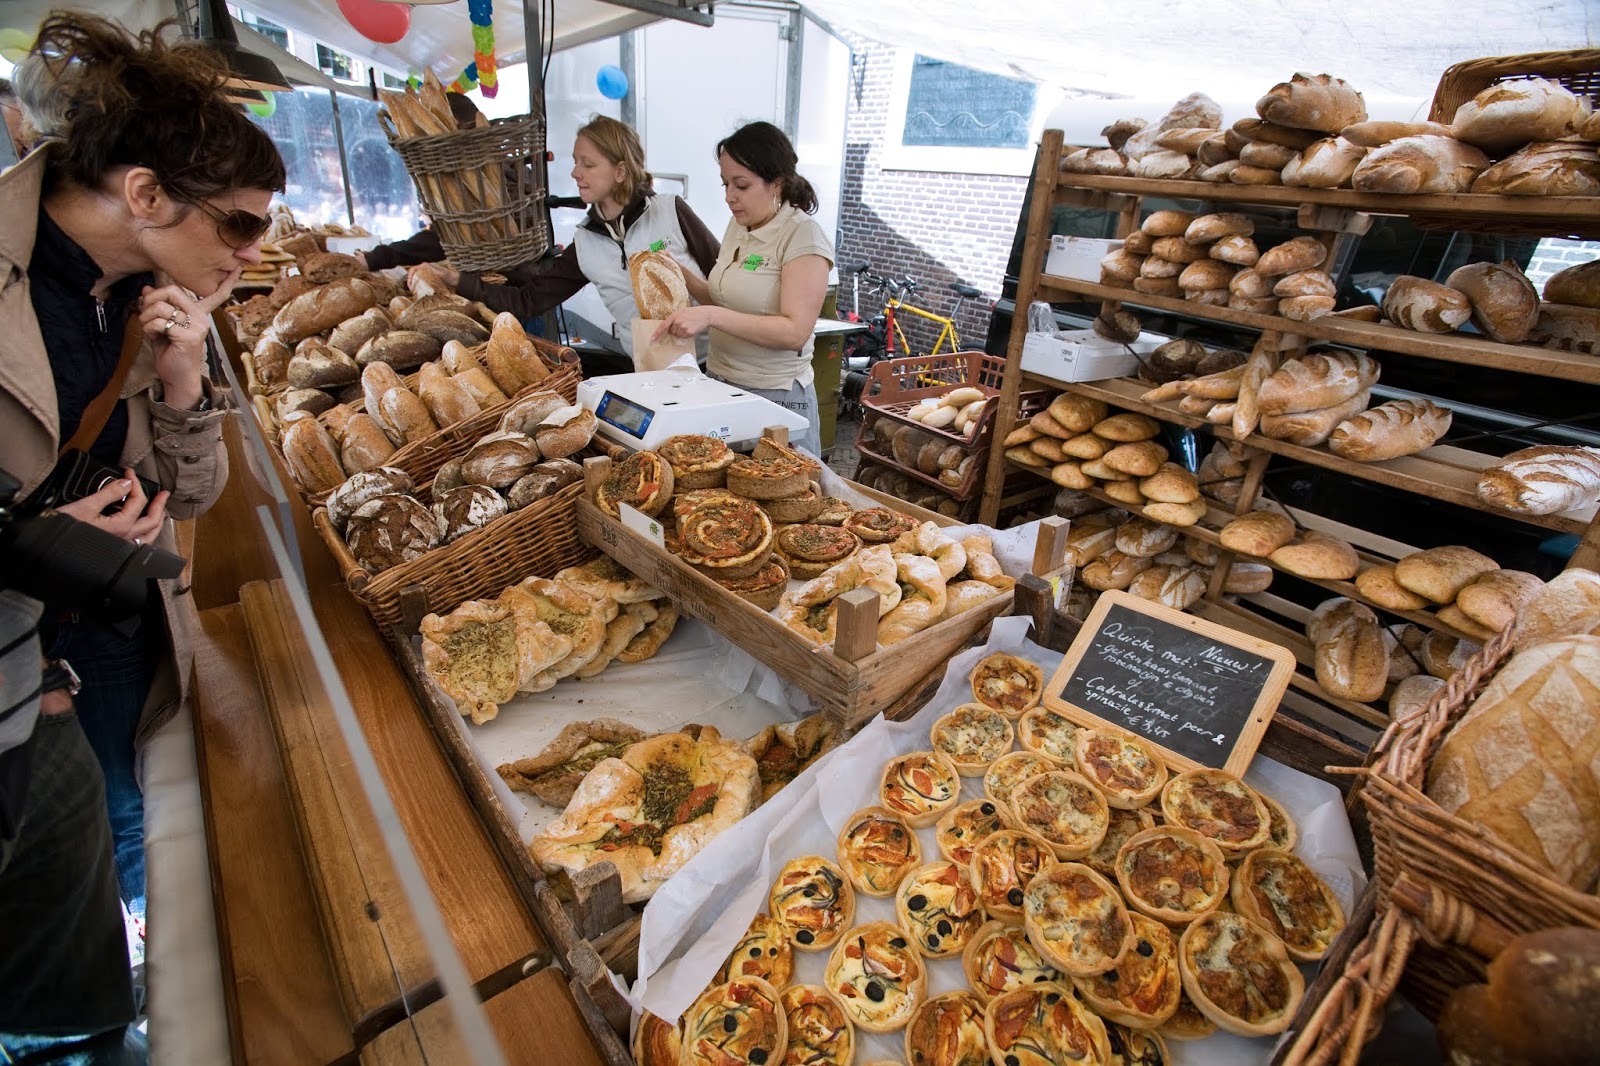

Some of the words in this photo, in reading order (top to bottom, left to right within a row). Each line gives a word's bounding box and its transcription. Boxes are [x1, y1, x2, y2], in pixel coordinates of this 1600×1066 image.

[1102, 622, 1154, 652] Quiche
[1125, 679, 1143, 691] of
[1084, 689, 1131, 715] spinazie
[1177, 721, 1213, 736] peer
